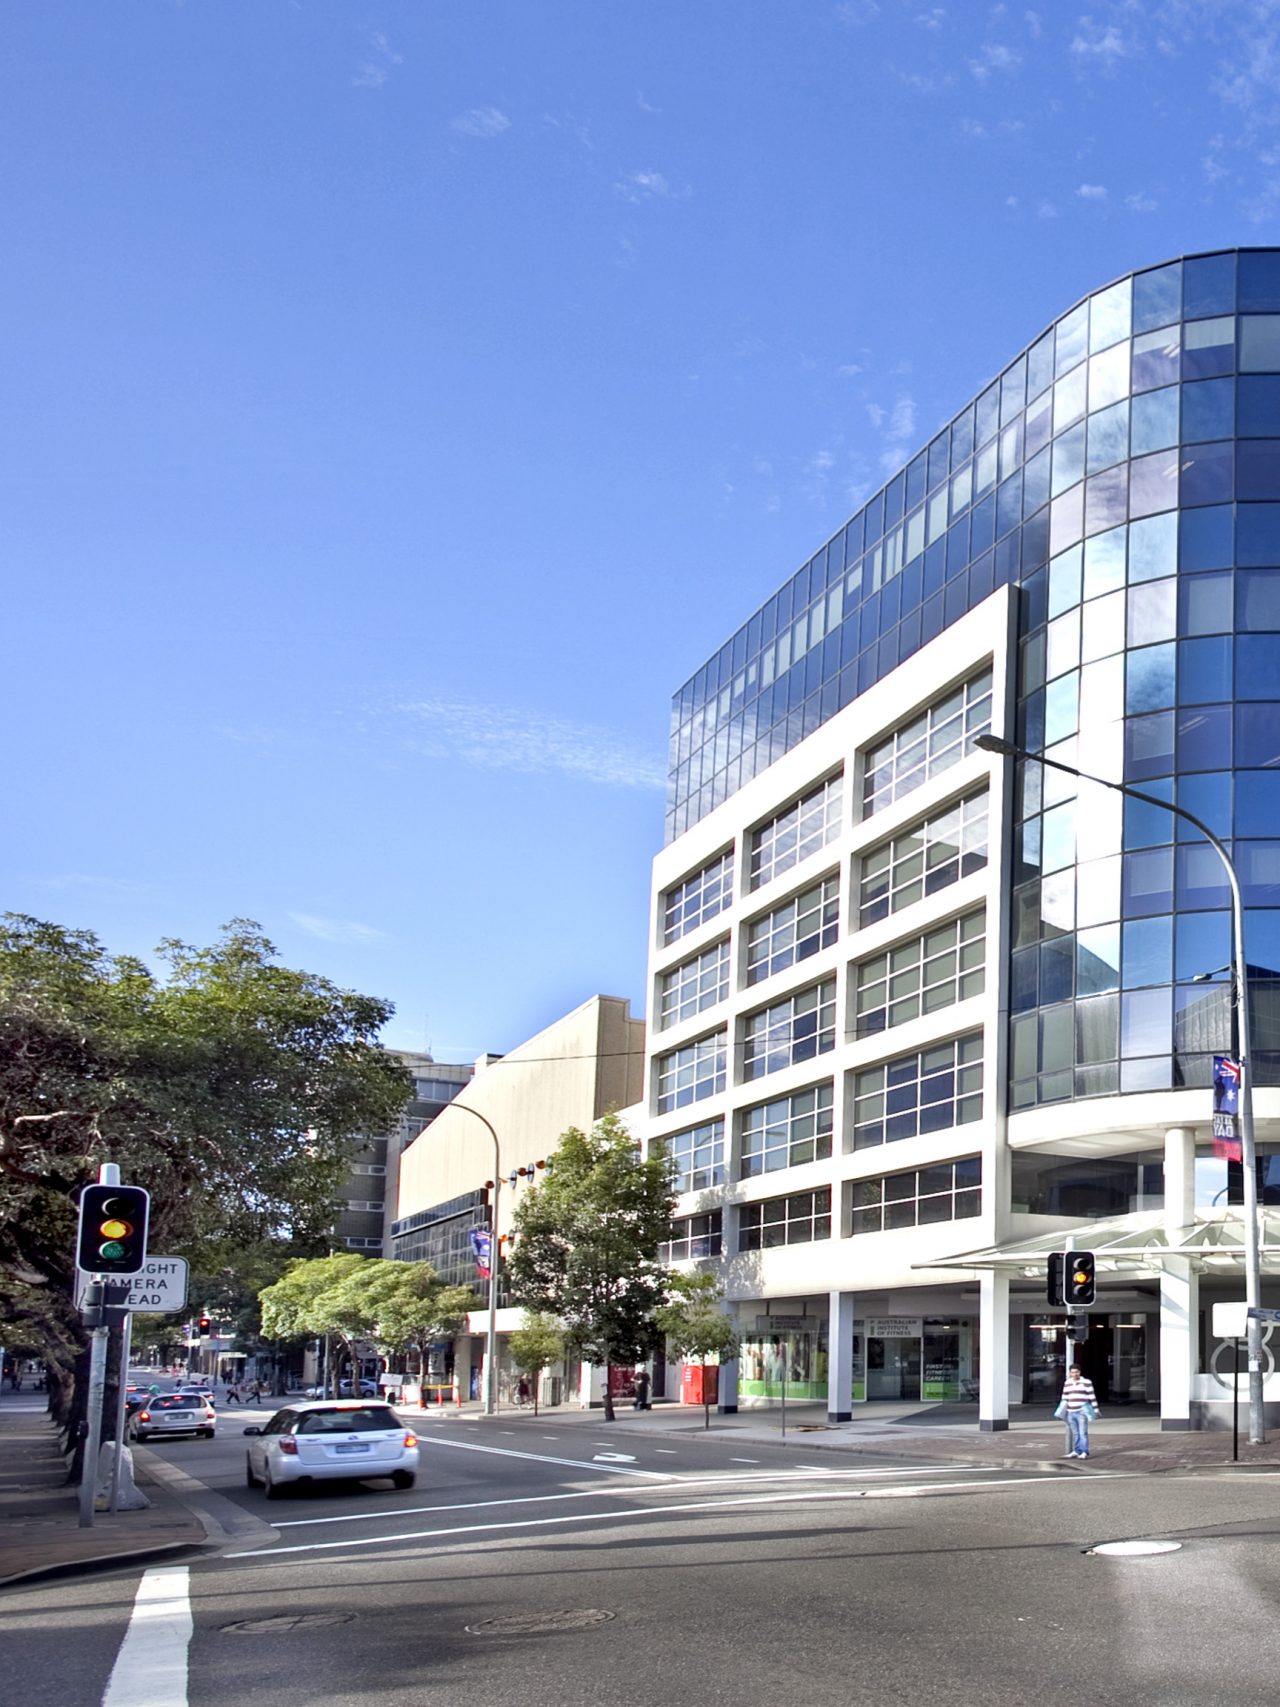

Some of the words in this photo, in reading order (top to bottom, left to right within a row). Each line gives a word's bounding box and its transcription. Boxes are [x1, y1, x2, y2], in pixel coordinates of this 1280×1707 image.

[140, 1263, 178, 1274] IGHT
[111, 1279, 168, 1289] AMERA
[128, 1294, 162, 1305] EAD
